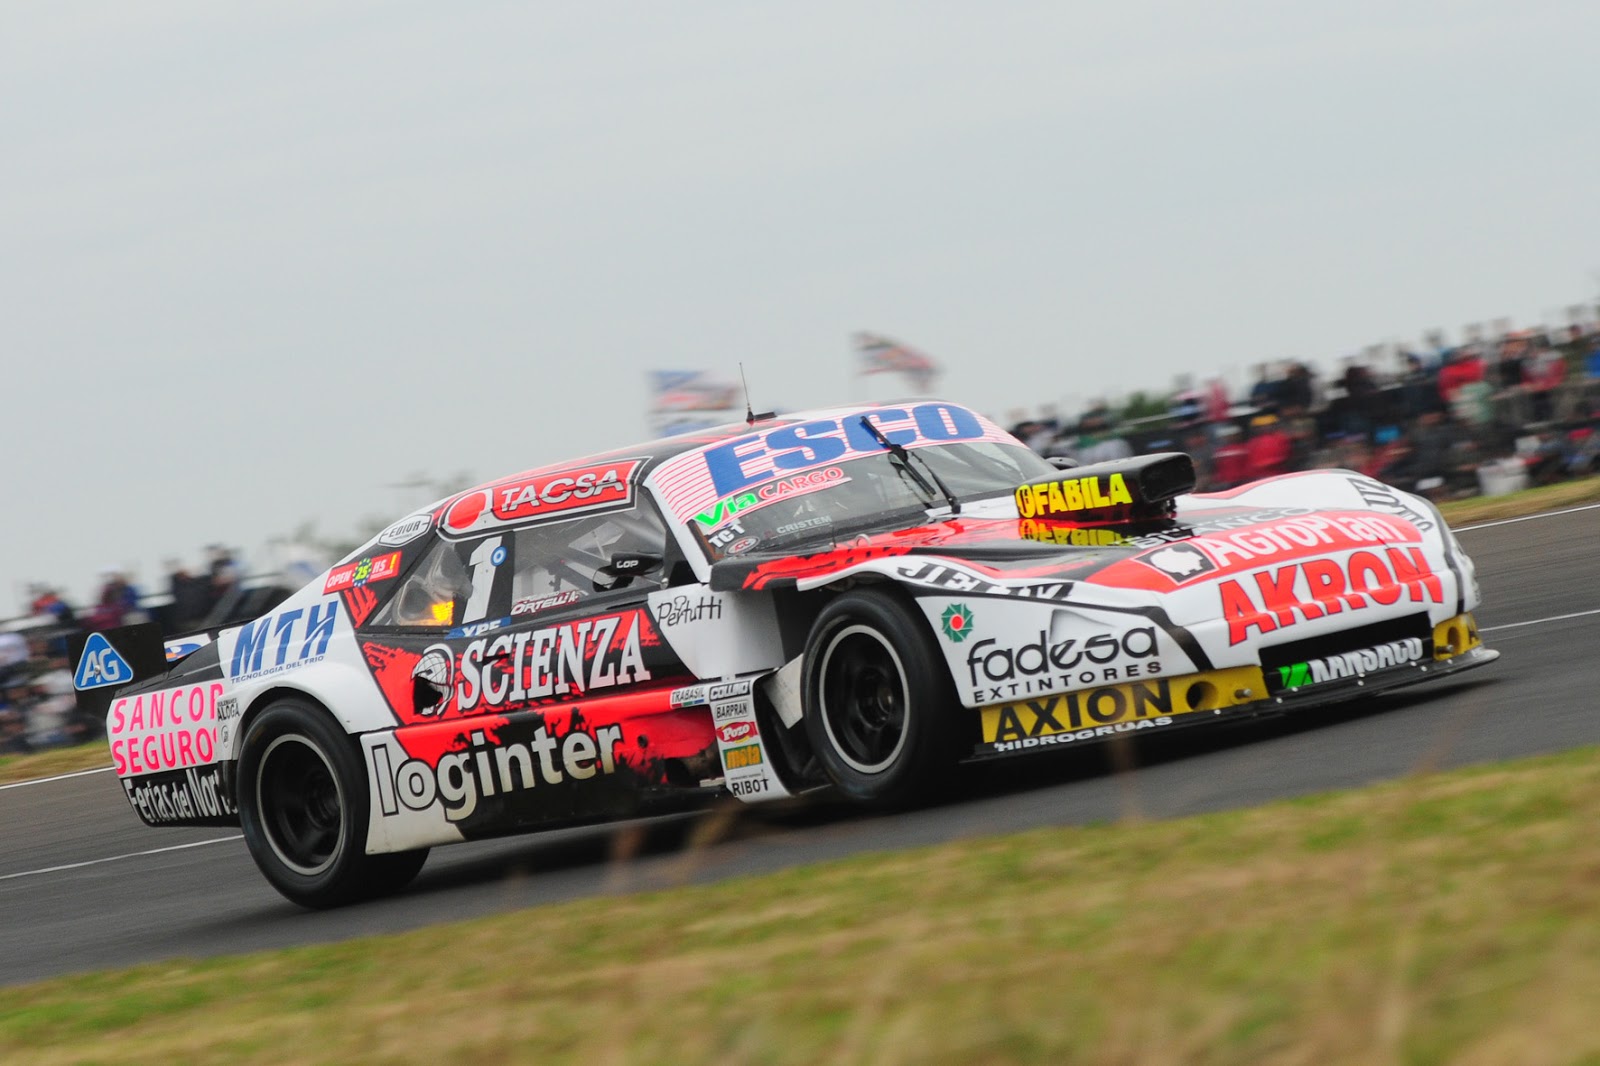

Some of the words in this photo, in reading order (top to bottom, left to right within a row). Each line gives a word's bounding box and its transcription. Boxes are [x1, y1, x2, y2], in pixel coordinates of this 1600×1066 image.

[704, 403, 984, 497] ESCO
[501, 469, 624, 512] TACSA
[694, 492, 758, 527] Via
[759, 467, 844, 500] CARGO
[1036, 473, 1132, 516] FABILA
[327, 570, 352, 588] OPEN
[462, 536, 502, 624] 1
[510, 593, 570, 615] ORTELLI
[1219, 547, 1443, 646] AKRON
[230, 601, 338, 678] MTH
[457, 611, 650, 712] SCIENZA
[967, 626, 1155, 687] fadesa
[81, 648, 119, 686] AG
[231, 665, 284, 684] TECNOLOGIA
[285, 661, 302, 671] DEL
[303, 655, 324, 667] FRIO
[974, 661, 1162, 703] EXTINTORES
[994, 716, 1173, 752] HIDROGRUAS
[995, 678, 1173, 742] AXION
[111, 727, 218, 775] SEGURO
[371, 724, 623, 821] loginter
